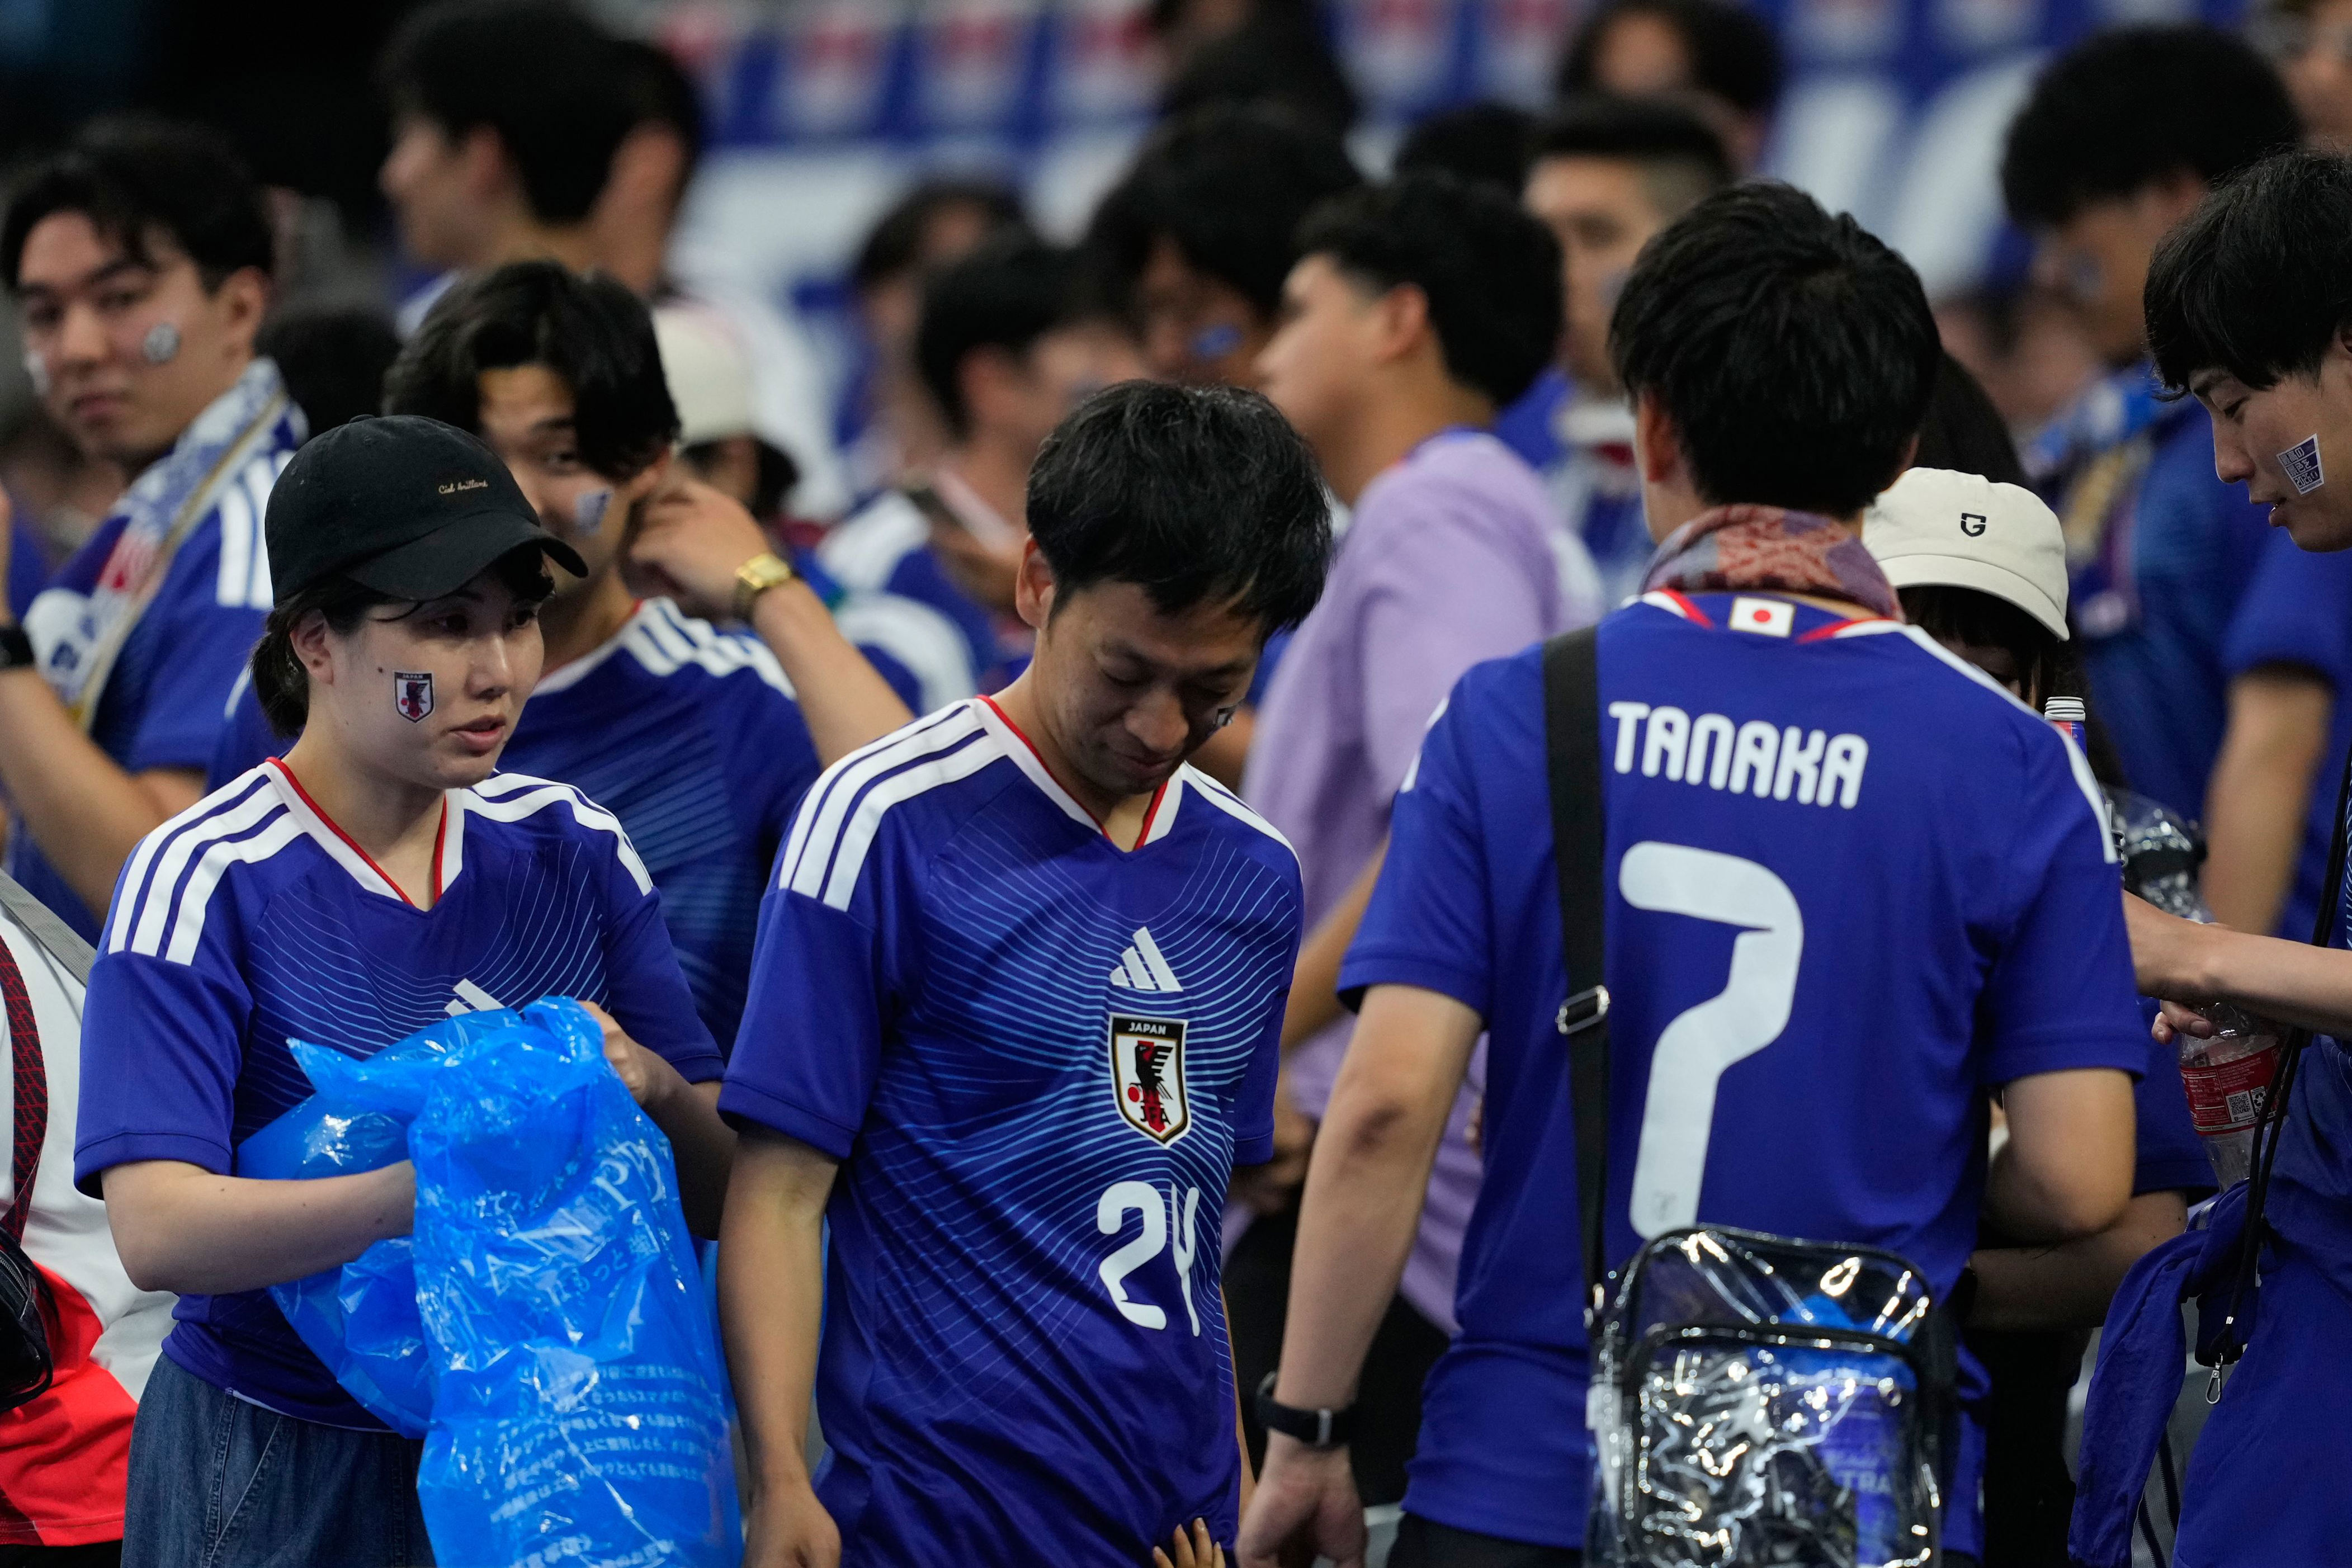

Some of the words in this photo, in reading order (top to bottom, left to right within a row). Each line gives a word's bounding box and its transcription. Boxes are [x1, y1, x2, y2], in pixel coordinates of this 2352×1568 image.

[1608, 701, 1869, 809] TANAKA
[1128, 1022, 1166, 1035] JAPAN
[1619, 840, 1804, 1241] 7
[1097, 1180, 1201, 1337] 24
